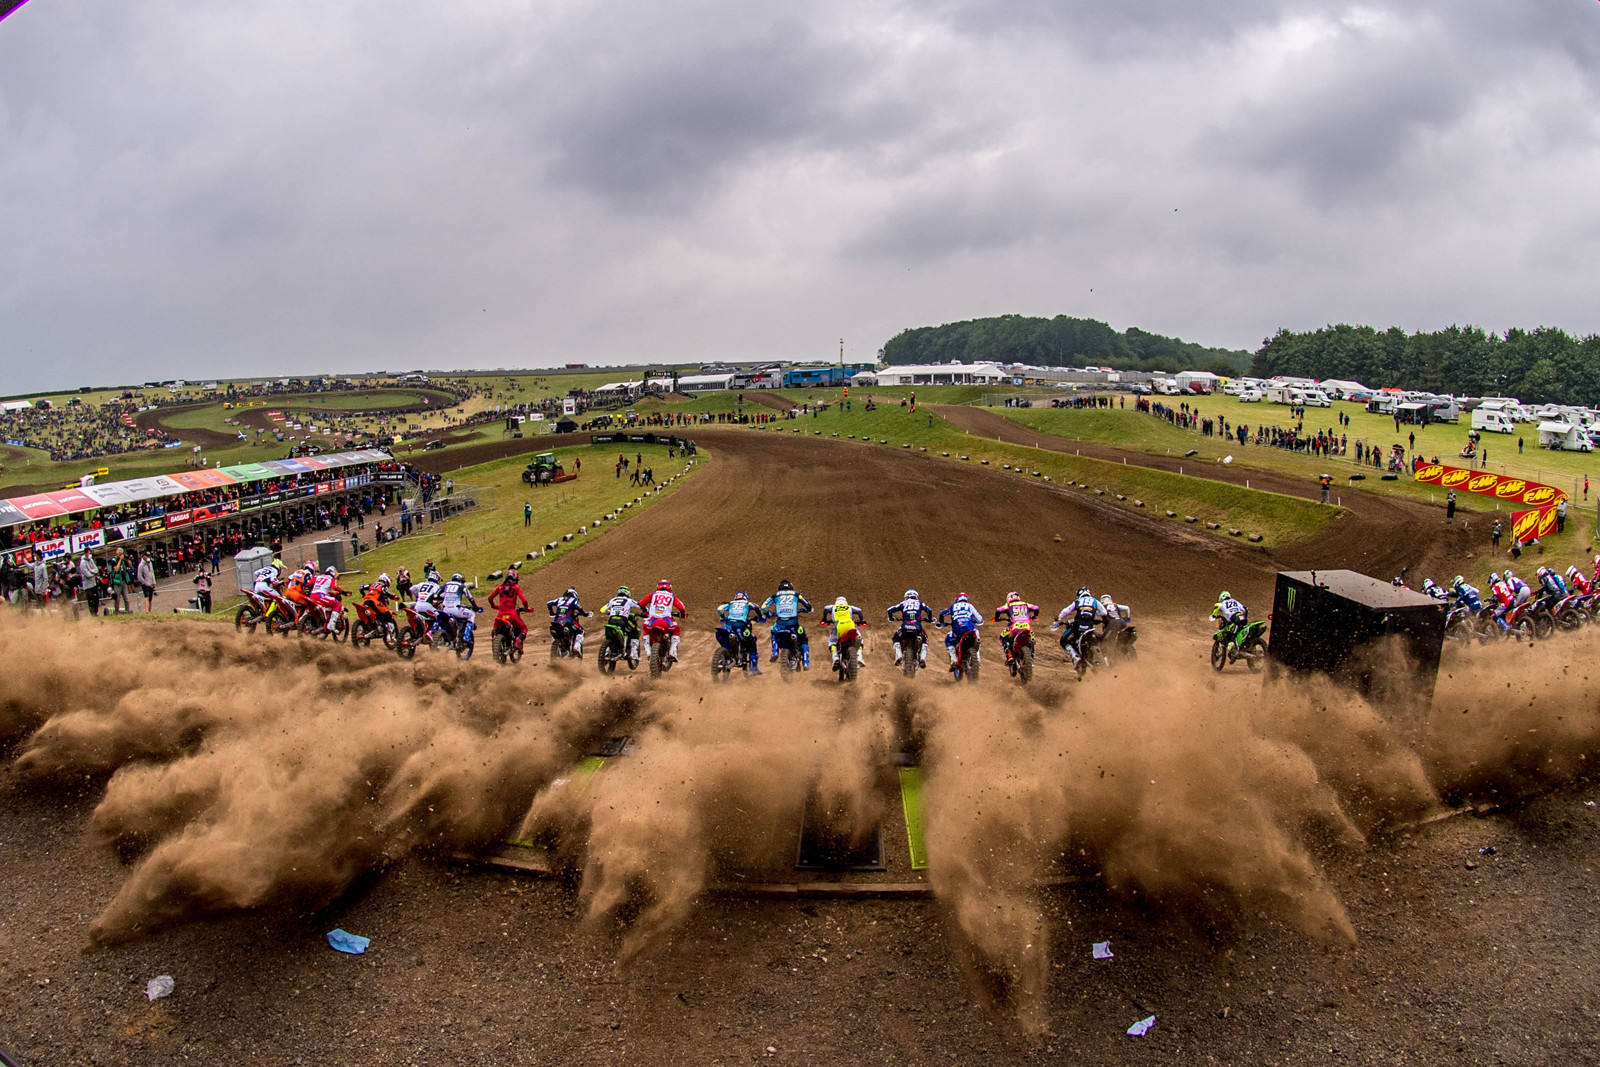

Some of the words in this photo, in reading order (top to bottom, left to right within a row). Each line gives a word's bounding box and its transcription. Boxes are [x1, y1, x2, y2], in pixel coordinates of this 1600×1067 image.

[1414, 464, 1444, 481] FMF
[1441, 469, 1470, 486] FMF
[1468, 474, 1498, 492] FMF
[1495, 479, 1526, 497] FMF
[1523, 486, 1555, 504] FMF
[1512, 510, 1540, 539] FMF
[78, 532, 100, 549] HRC
[420, 584, 434, 593] 61
[446, 584, 459, 593] 10
[612, 597, 628, 608] 3
[653, 594, 673, 606] 189
[779, 595, 794, 605] 22
